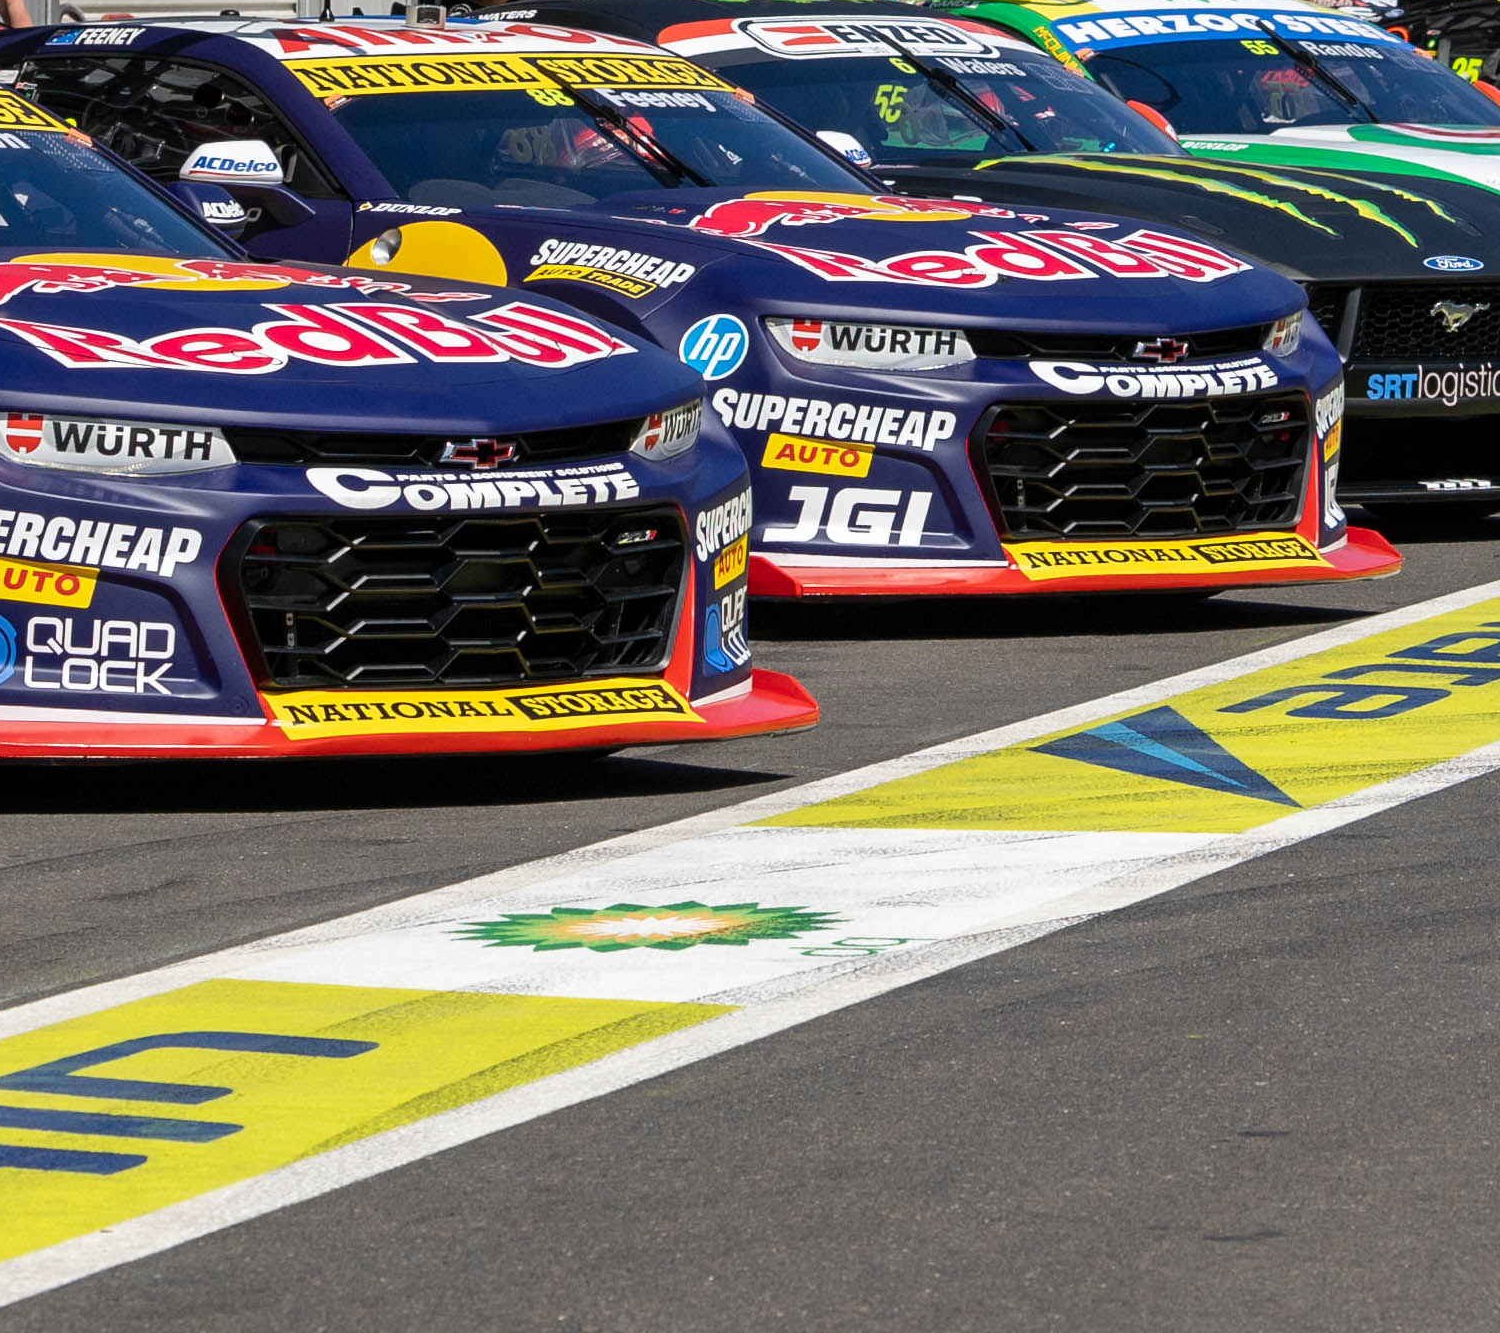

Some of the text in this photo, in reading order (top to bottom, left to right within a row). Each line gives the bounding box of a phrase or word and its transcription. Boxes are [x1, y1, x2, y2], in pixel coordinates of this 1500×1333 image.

[477, 9, 538, 22] WATERS
[929, 0, 980, 9] RANDLE
[74, 27, 145, 46] FEENEY
[837, 23, 968, 46] ENZED
[1070, 11, 1399, 44] HERZOG STEEL
[1246, 39, 1280, 56] 55
[1298, 39, 1384, 61] Randle
[303, 58, 724, 95] NATIONAL STORAGE
[890, 57, 916, 75] 6
[937, 55, 1028, 78] Waters
[530, 87, 575, 107] 88
[600, 88, 715, 113] Feeney
[1182, 140, 1250, 152] DUNLOP
[192, 153, 278, 177] ACDelco
[372, 202, 462, 217] DUNLOP
[529, 238, 696, 289] SUPERCHEAP
[1433, 256, 1478, 271] Ford
[539, 266, 645, 299] AUTO TRADE
[691, 318, 739, 379] hp
[830, 323, 959, 357] WÜRTH
[1028, 359, 1280, 398] COMPLETE
[710, 387, 957, 451] SUPERCHEAP
[54, 420, 214, 463] WÜRTH
[774, 441, 861, 470] AUTO
[305, 465, 642, 512] COMPLETE
[763, 485, 934, 548] JGI
[717, 544, 744, 578] AUTO
[1022, 536, 1310, 572] NATIONAL STORAGE
[26, 617, 176, 659] QUAD
[23, 654, 173, 695] LOCK
[282, 685, 682, 727] NATIONAL STORAGE
